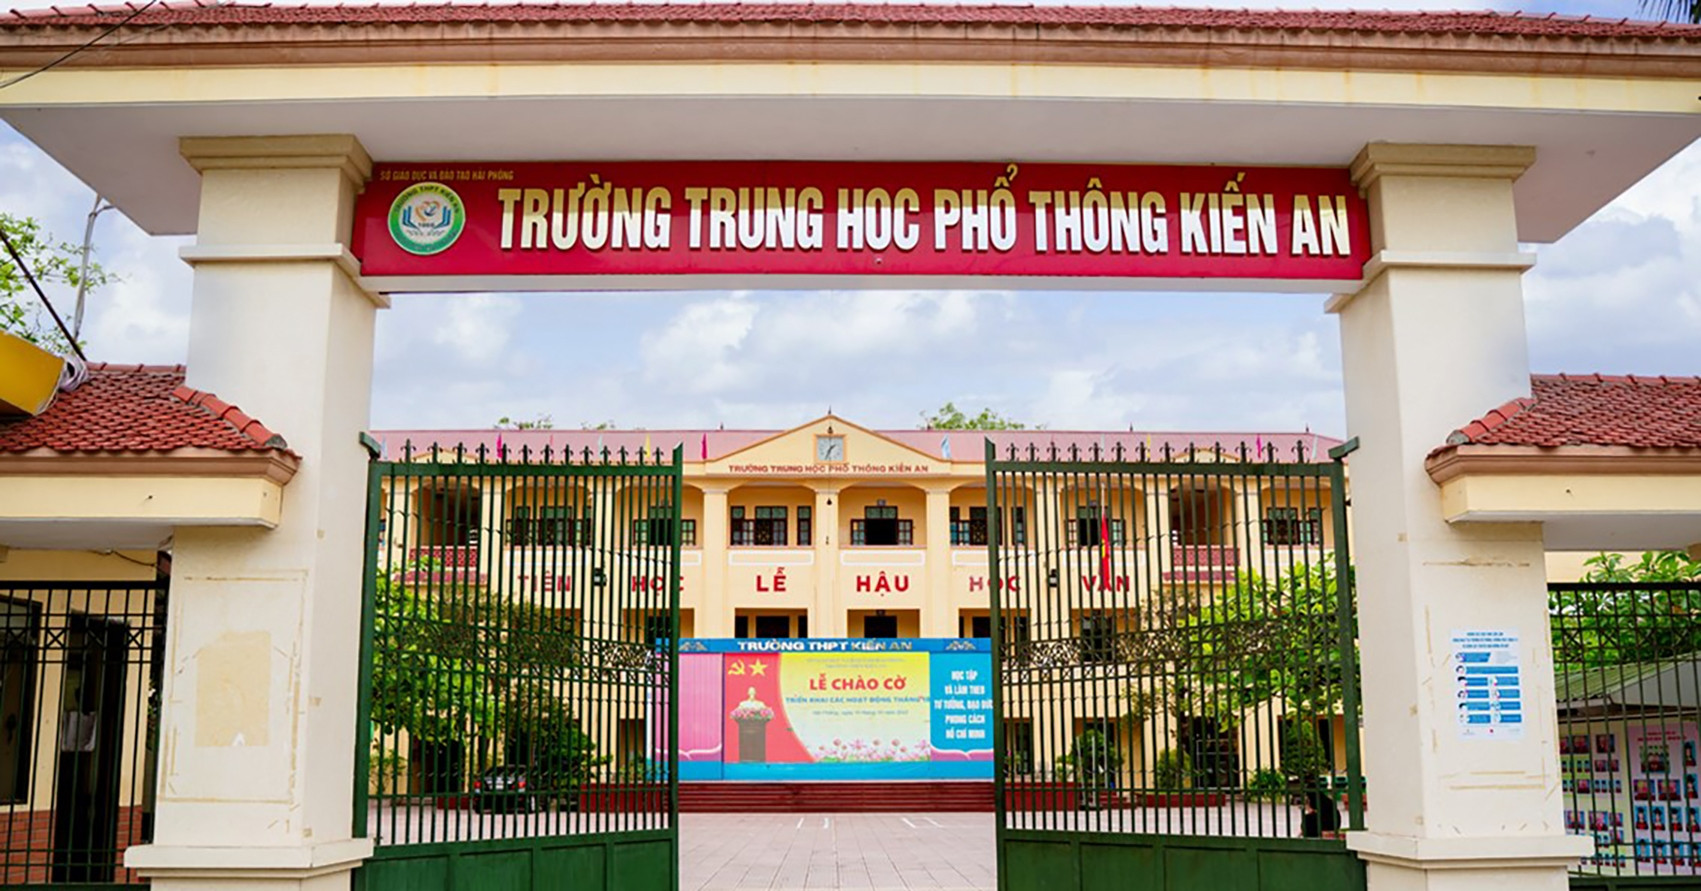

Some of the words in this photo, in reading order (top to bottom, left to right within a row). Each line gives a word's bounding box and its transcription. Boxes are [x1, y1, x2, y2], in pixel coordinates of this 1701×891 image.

[498, 174, 672, 250] TRƯỜNG
[685, 186, 823, 250] TRUNG
[933, 163, 1018, 252] PHỔ
[1028, 177, 1169, 254] THÔNG
[1180, 171, 1277, 255] KIẾN
[1291, 194, 1352, 256] AN
[914, 464, 929, 472] AN
[631, 575, 684, 597] HỌ
[756, 566, 787, 592] LỄ
[856, 570, 909, 597] HẬU
[737, 638, 804, 651] TRƯỜNG
[808, 641, 848, 651] THPT
[889, 641, 913, 651] AN
[809, 672, 827, 691] LỄ
[831, 674, 879, 691] CHÀO
[883, 674, 907, 691] CỜ
